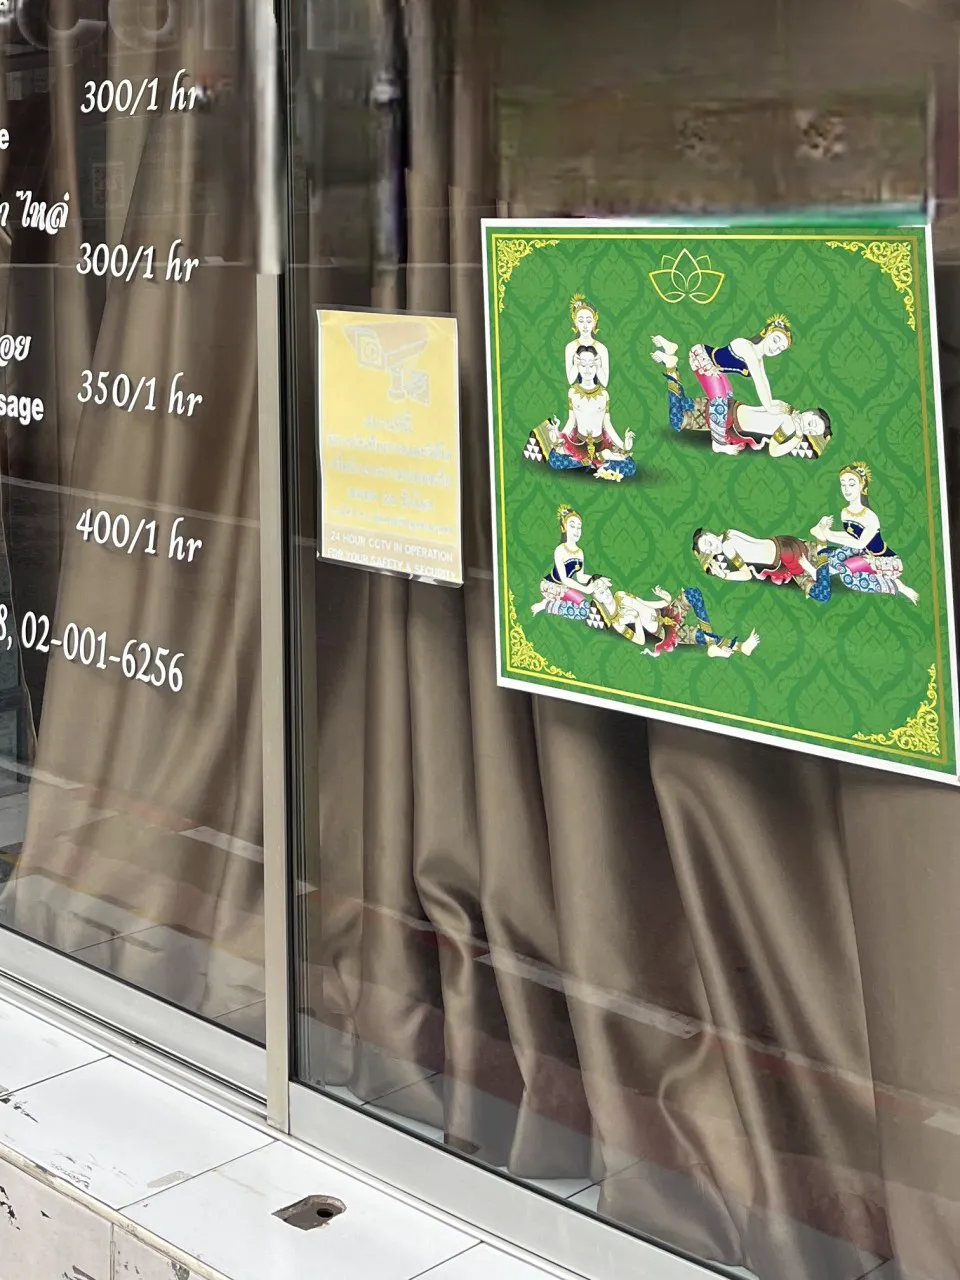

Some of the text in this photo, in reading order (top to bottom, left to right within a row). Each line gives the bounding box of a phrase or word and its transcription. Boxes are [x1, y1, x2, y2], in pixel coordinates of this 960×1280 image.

[80, 68, 199, 116] 300/1 hr
[15, 190, 71, 235] ไหล่
[76, 238, 200, 282] 300/1 hr
[77, 369, 203, 417] 350/1 hr
[76, 507, 203, 563] 400/1 hr
[330, 531, 453, 562] 24 HOUR CCTV IN OPERATION
[369, 553, 403, 569] SAFETY
[414, 563, 456, 578] SECURITY
[21, 610, 185, 693] 02-001-6256
